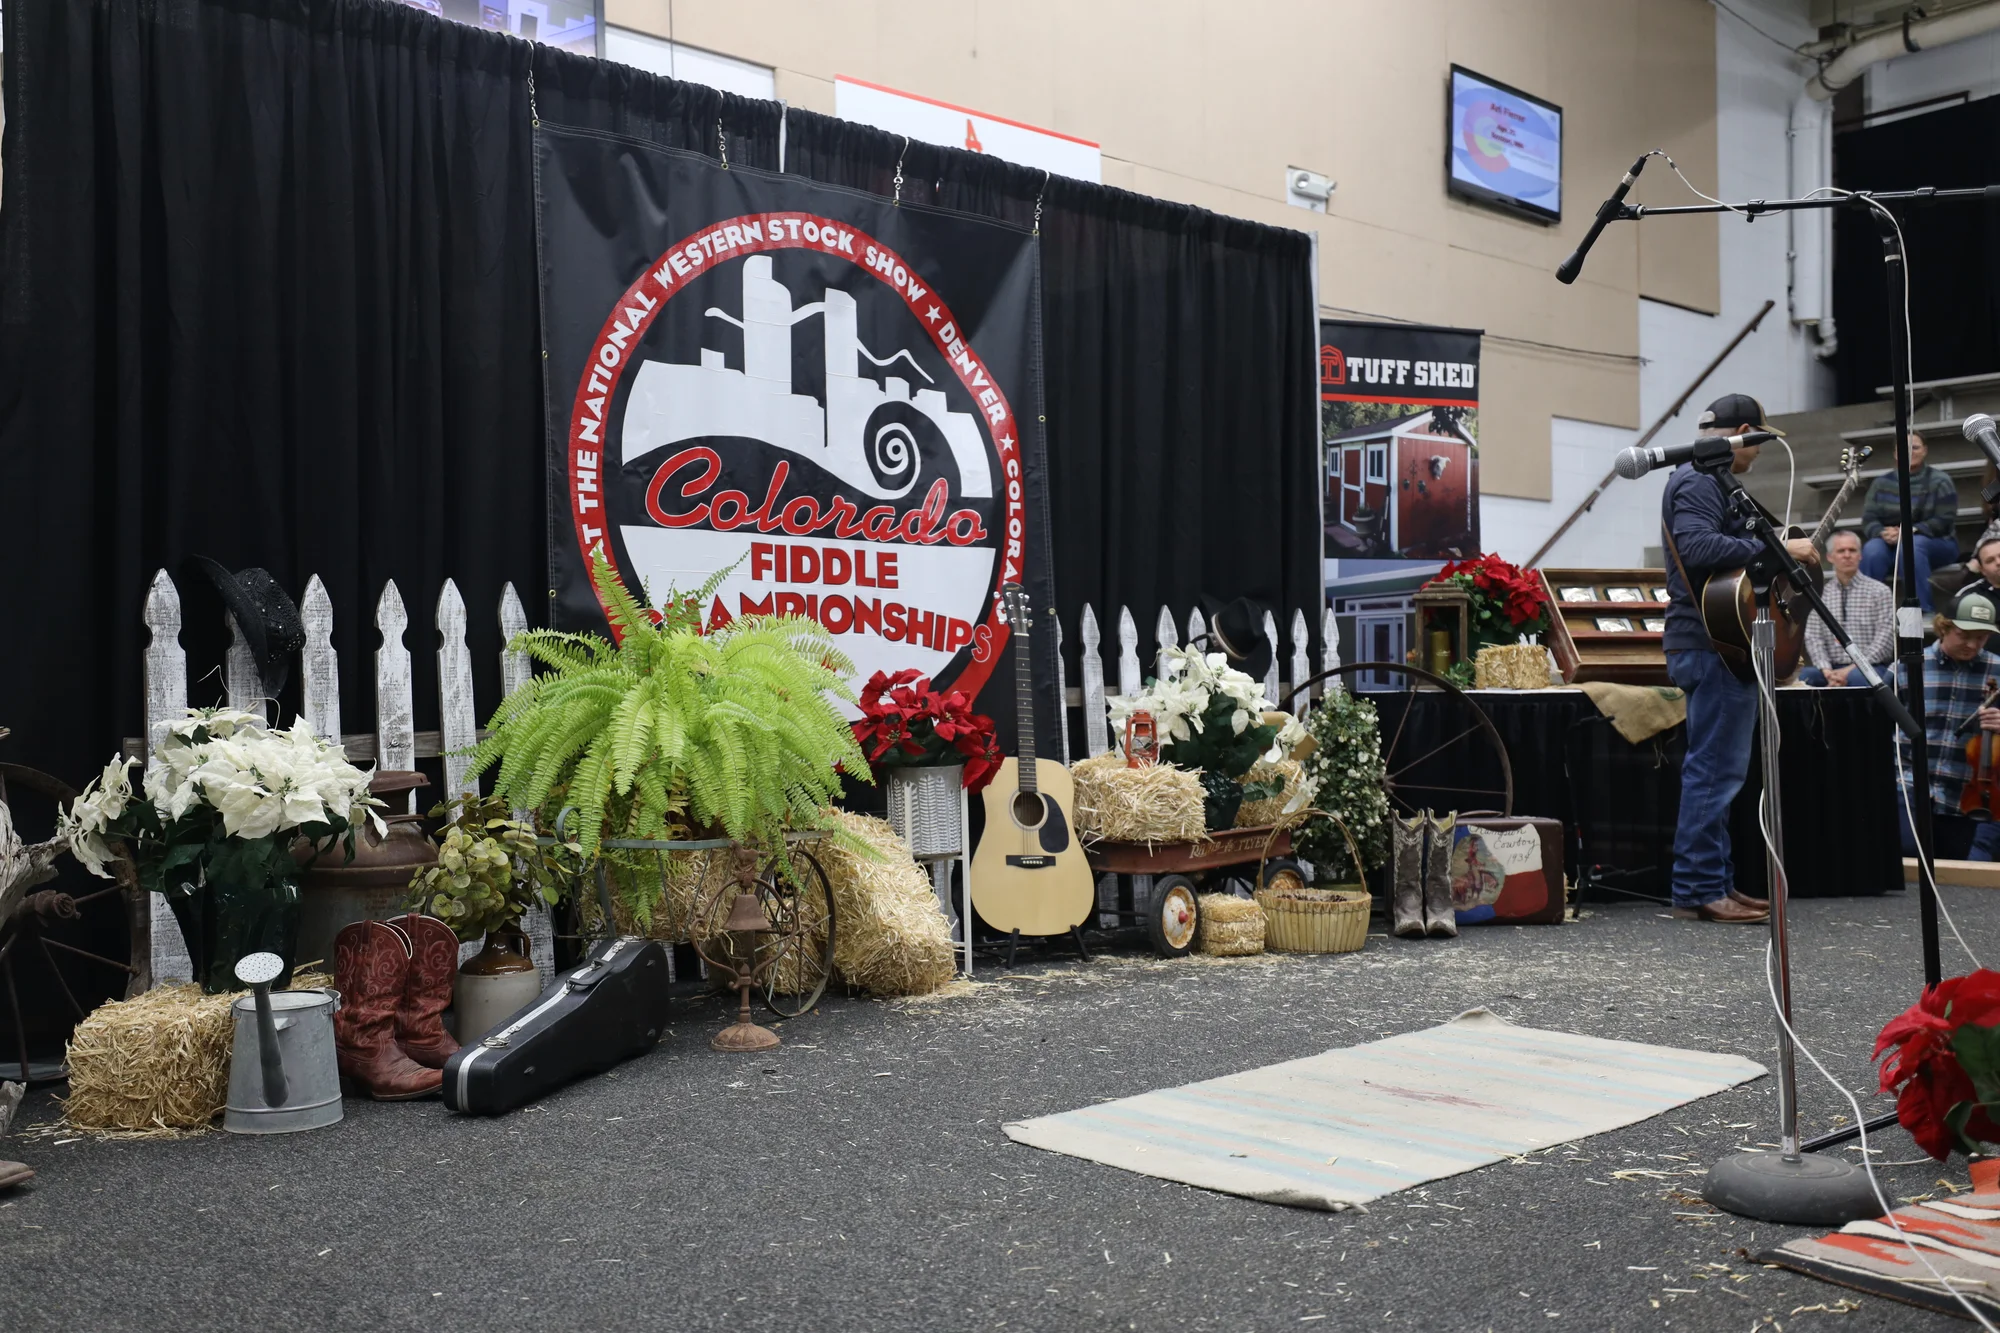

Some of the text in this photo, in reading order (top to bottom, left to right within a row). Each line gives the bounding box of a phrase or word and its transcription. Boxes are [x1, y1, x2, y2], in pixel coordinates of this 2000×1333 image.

[653, 219, 764, 290] WESTERN
[768, 219, 854, 254] STOCK
[865, 245, 927, 302] SHOW
[578, 290, 657, 444] NATIONAL
[938, 321, 1006, 426] DENVER
[1346, 356, 1475, 388] TUFF SHED
[577, 449, 598, 514] THE
[645, 446, 988, 545] Colorado
[750, 542, 899, 589] FIDDLE
[996, 458, 1021, 625] COLORA
[640, 590, 993, 663] AMPIONSHIPS
[1493, 837, 1537, 856] Cowboy
